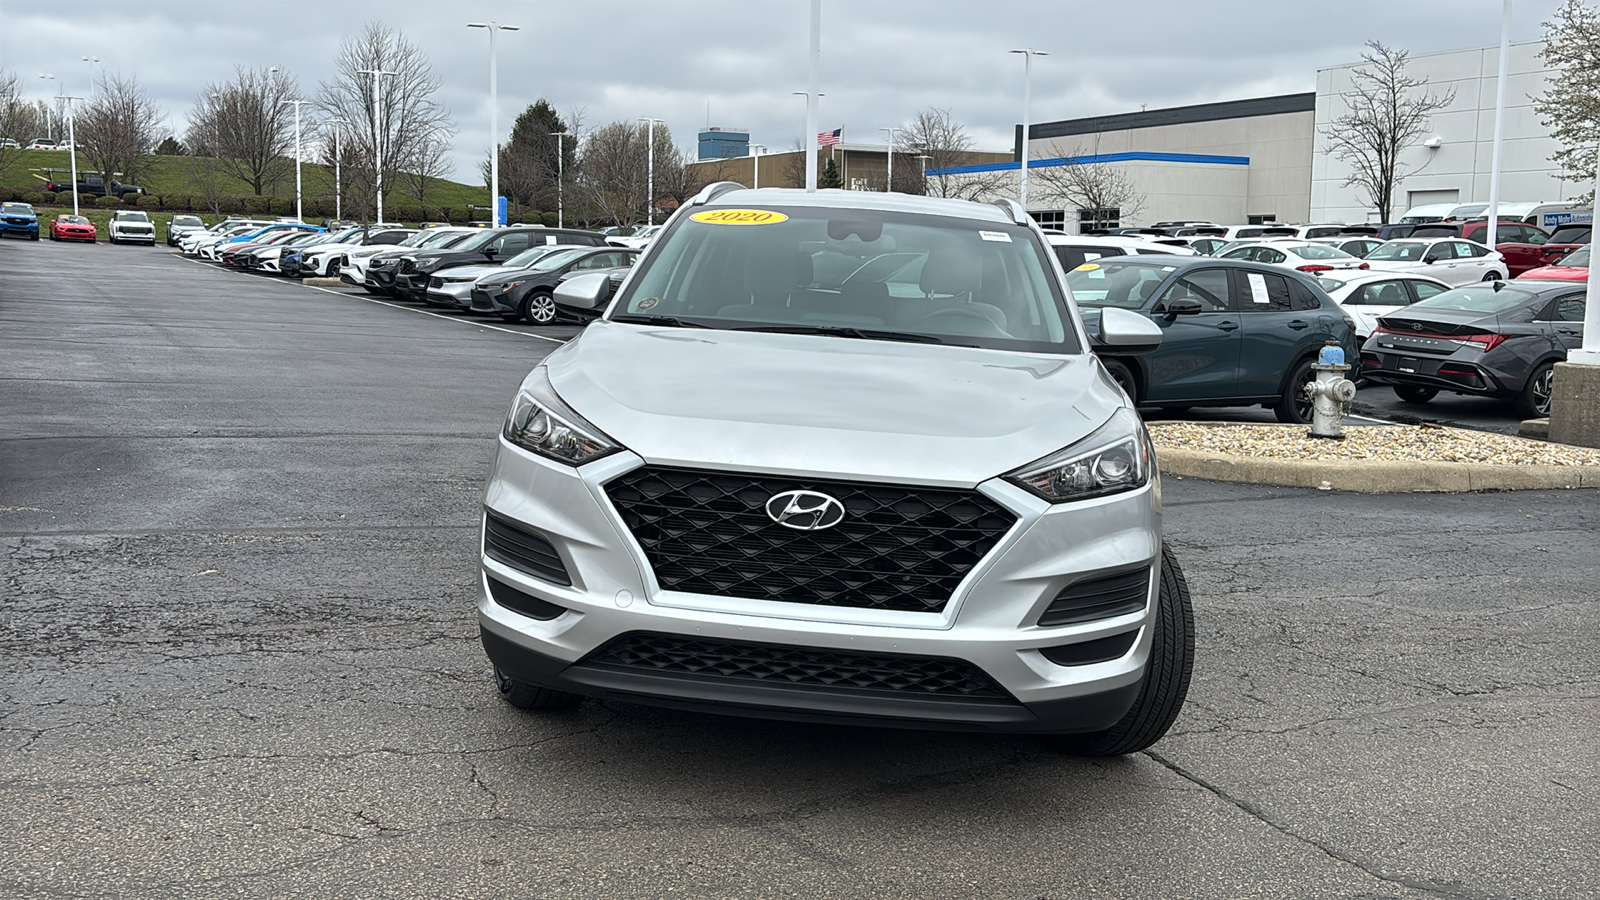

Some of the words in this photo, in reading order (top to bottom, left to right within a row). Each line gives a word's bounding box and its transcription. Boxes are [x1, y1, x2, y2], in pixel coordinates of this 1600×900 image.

[704, 212, 773, 222] 2020
[1545, 215, 1558, 225] Andy
[1393, 337, 1439, 345] ELANTRA
